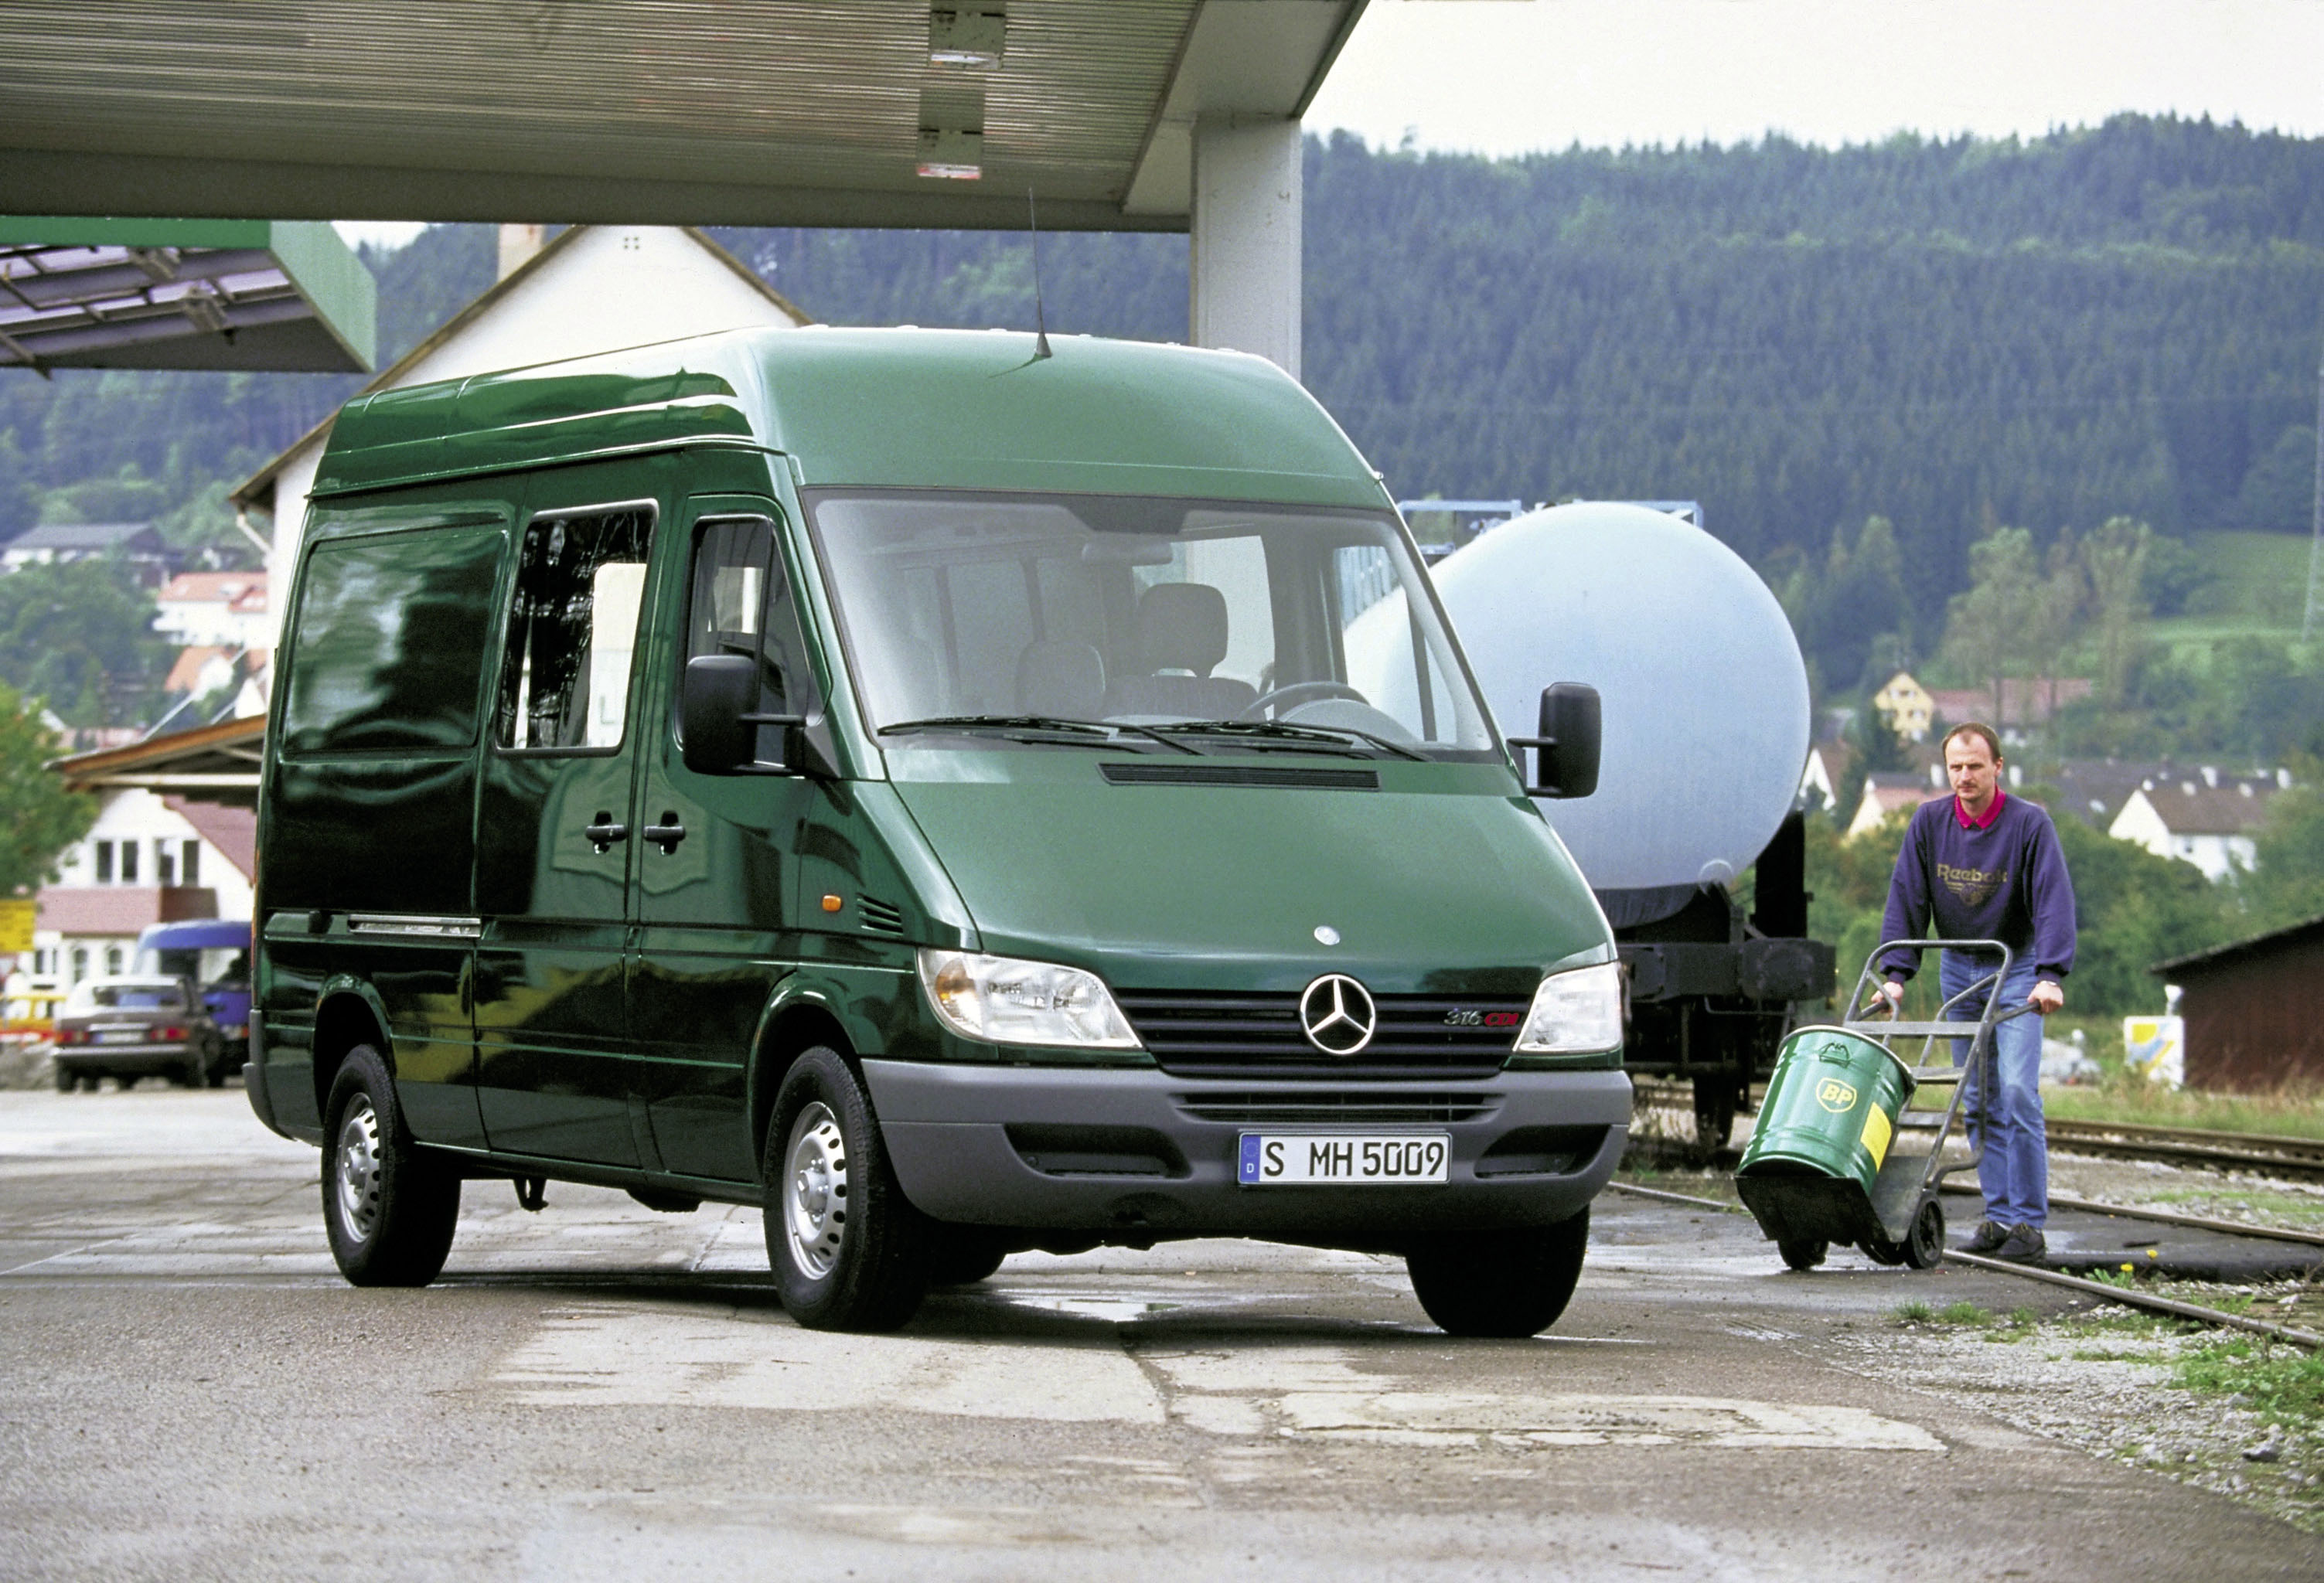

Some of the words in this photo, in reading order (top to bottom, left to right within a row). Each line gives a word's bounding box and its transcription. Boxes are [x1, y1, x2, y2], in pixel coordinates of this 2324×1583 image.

[1443, 1008, 1483, 1026] 316
[1484, 1013, 1519, 1026] CDI
[1821, 1084, 1853, 1105] BP
[1246, 1163, 1255, 1173] D
[1264, 1142, 1284, 1176] S
[1309, 1142, 1353, 1176] MH
[1362, 1142, 1444, 1176] 5009
